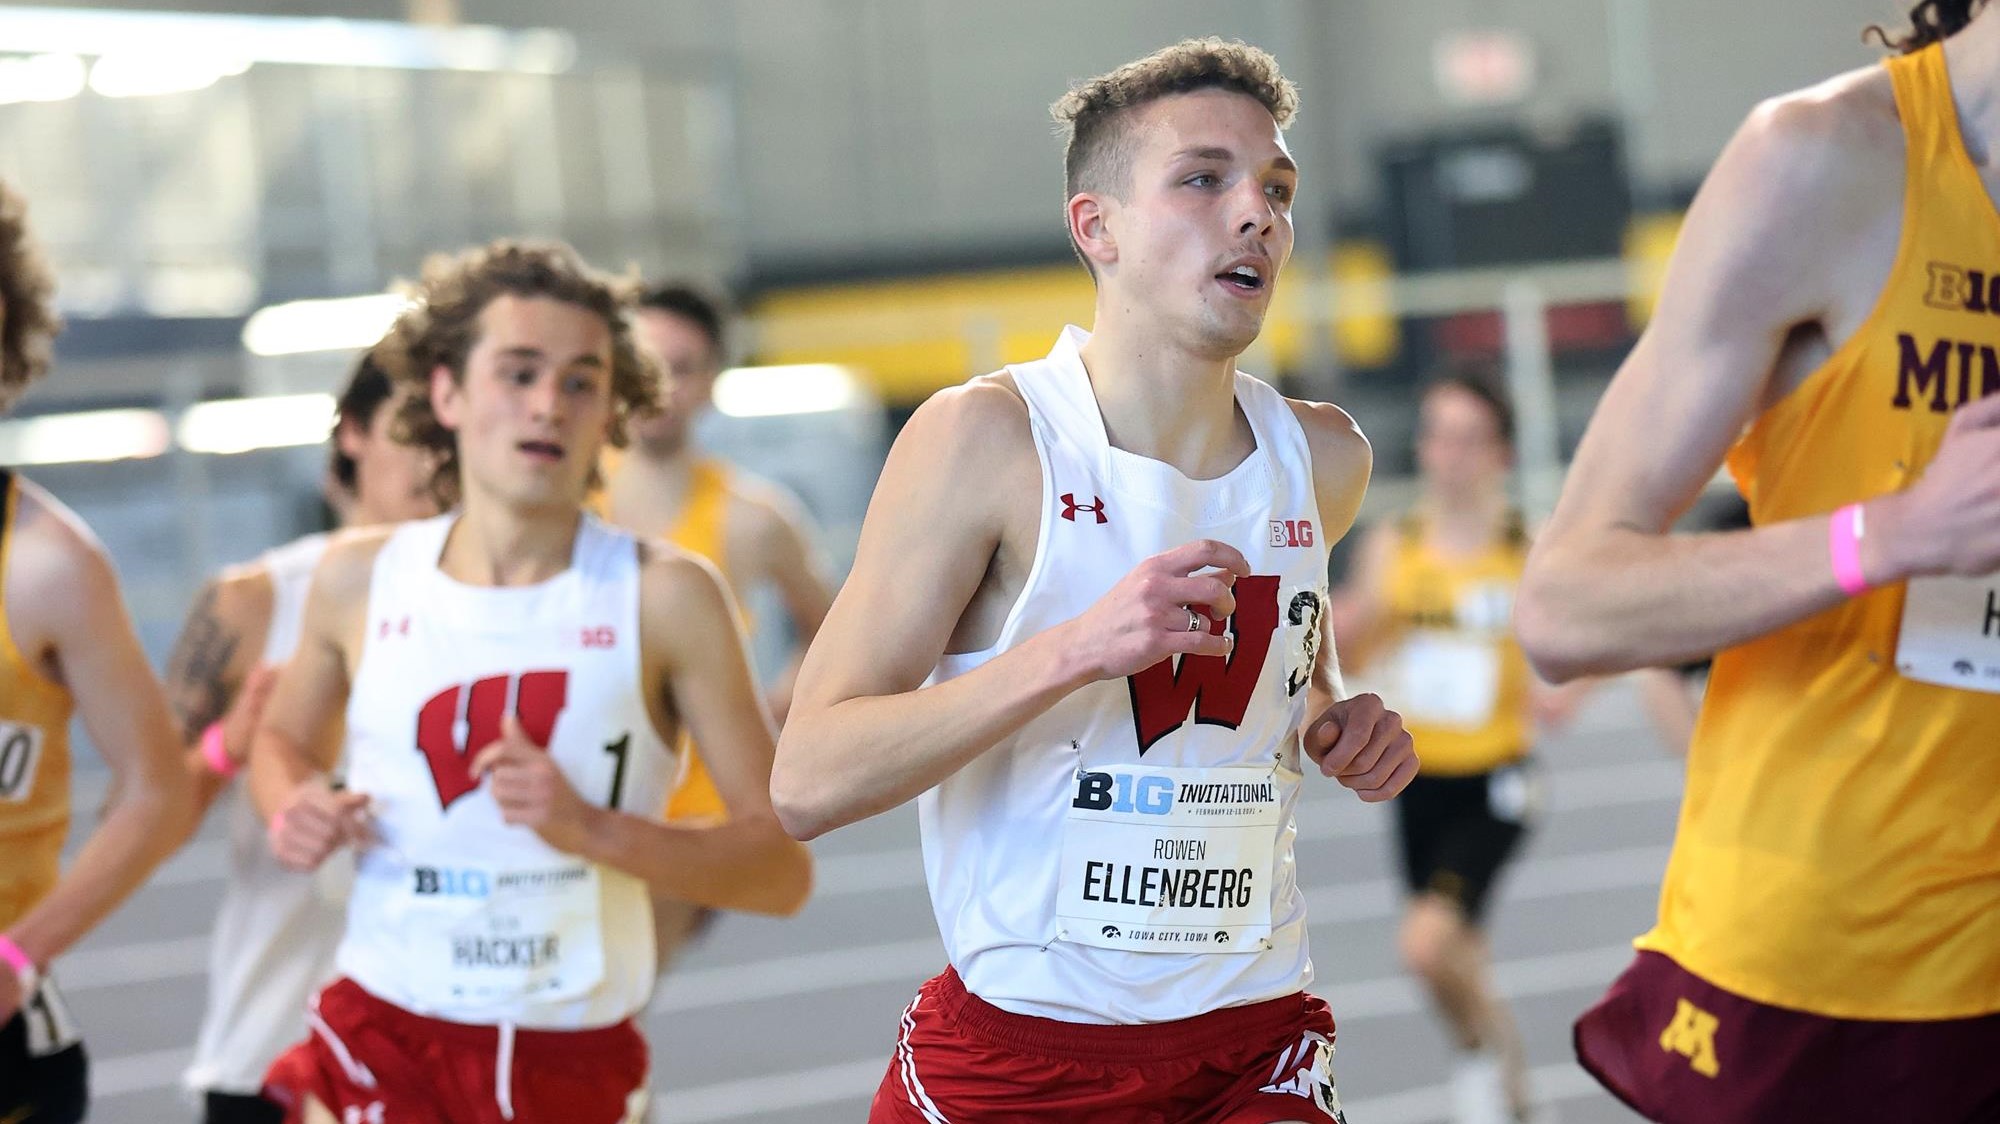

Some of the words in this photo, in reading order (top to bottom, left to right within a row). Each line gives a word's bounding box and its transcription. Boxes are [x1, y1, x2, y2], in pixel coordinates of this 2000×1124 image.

[0, 731, 31, 795] 0
[603, 732, 630, 809] 1
[1177, 783, 1275, 803] INVITATIONAL
[1154, 839, 1207, 861] ROWEN
[1083, 861, 1253, 908] ELLENBERG
[1129, 930, 1155, 941] IOWA
[1158, 932, 1181, 942] CITY,
[1184, 933, 1208, 942] IOWA
